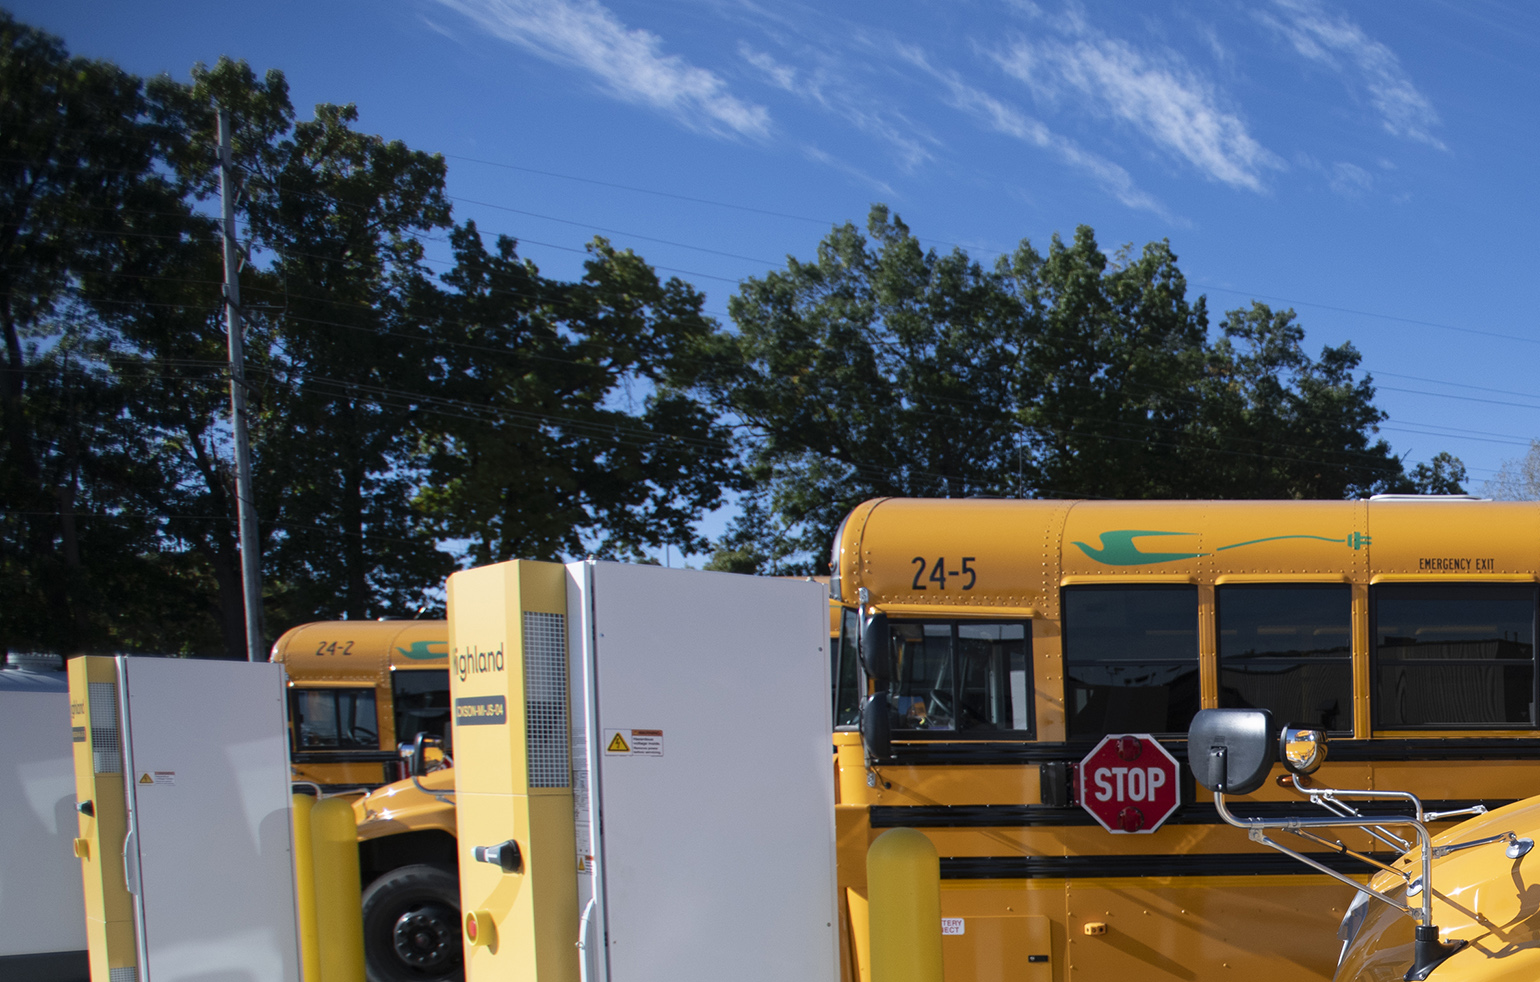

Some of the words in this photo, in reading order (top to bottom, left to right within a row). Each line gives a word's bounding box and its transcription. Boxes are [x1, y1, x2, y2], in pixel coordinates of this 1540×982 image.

[911, 556, 977, 591] 24-5
[1419, 558, 1471, 570] EMERGENCY
[1476, 558, 1495, 570] EXIT
[315, 640, 355, 656] 24-2
[454, 642, 505, 682] ighland
[1094, 767, 1166, 802] STOP
